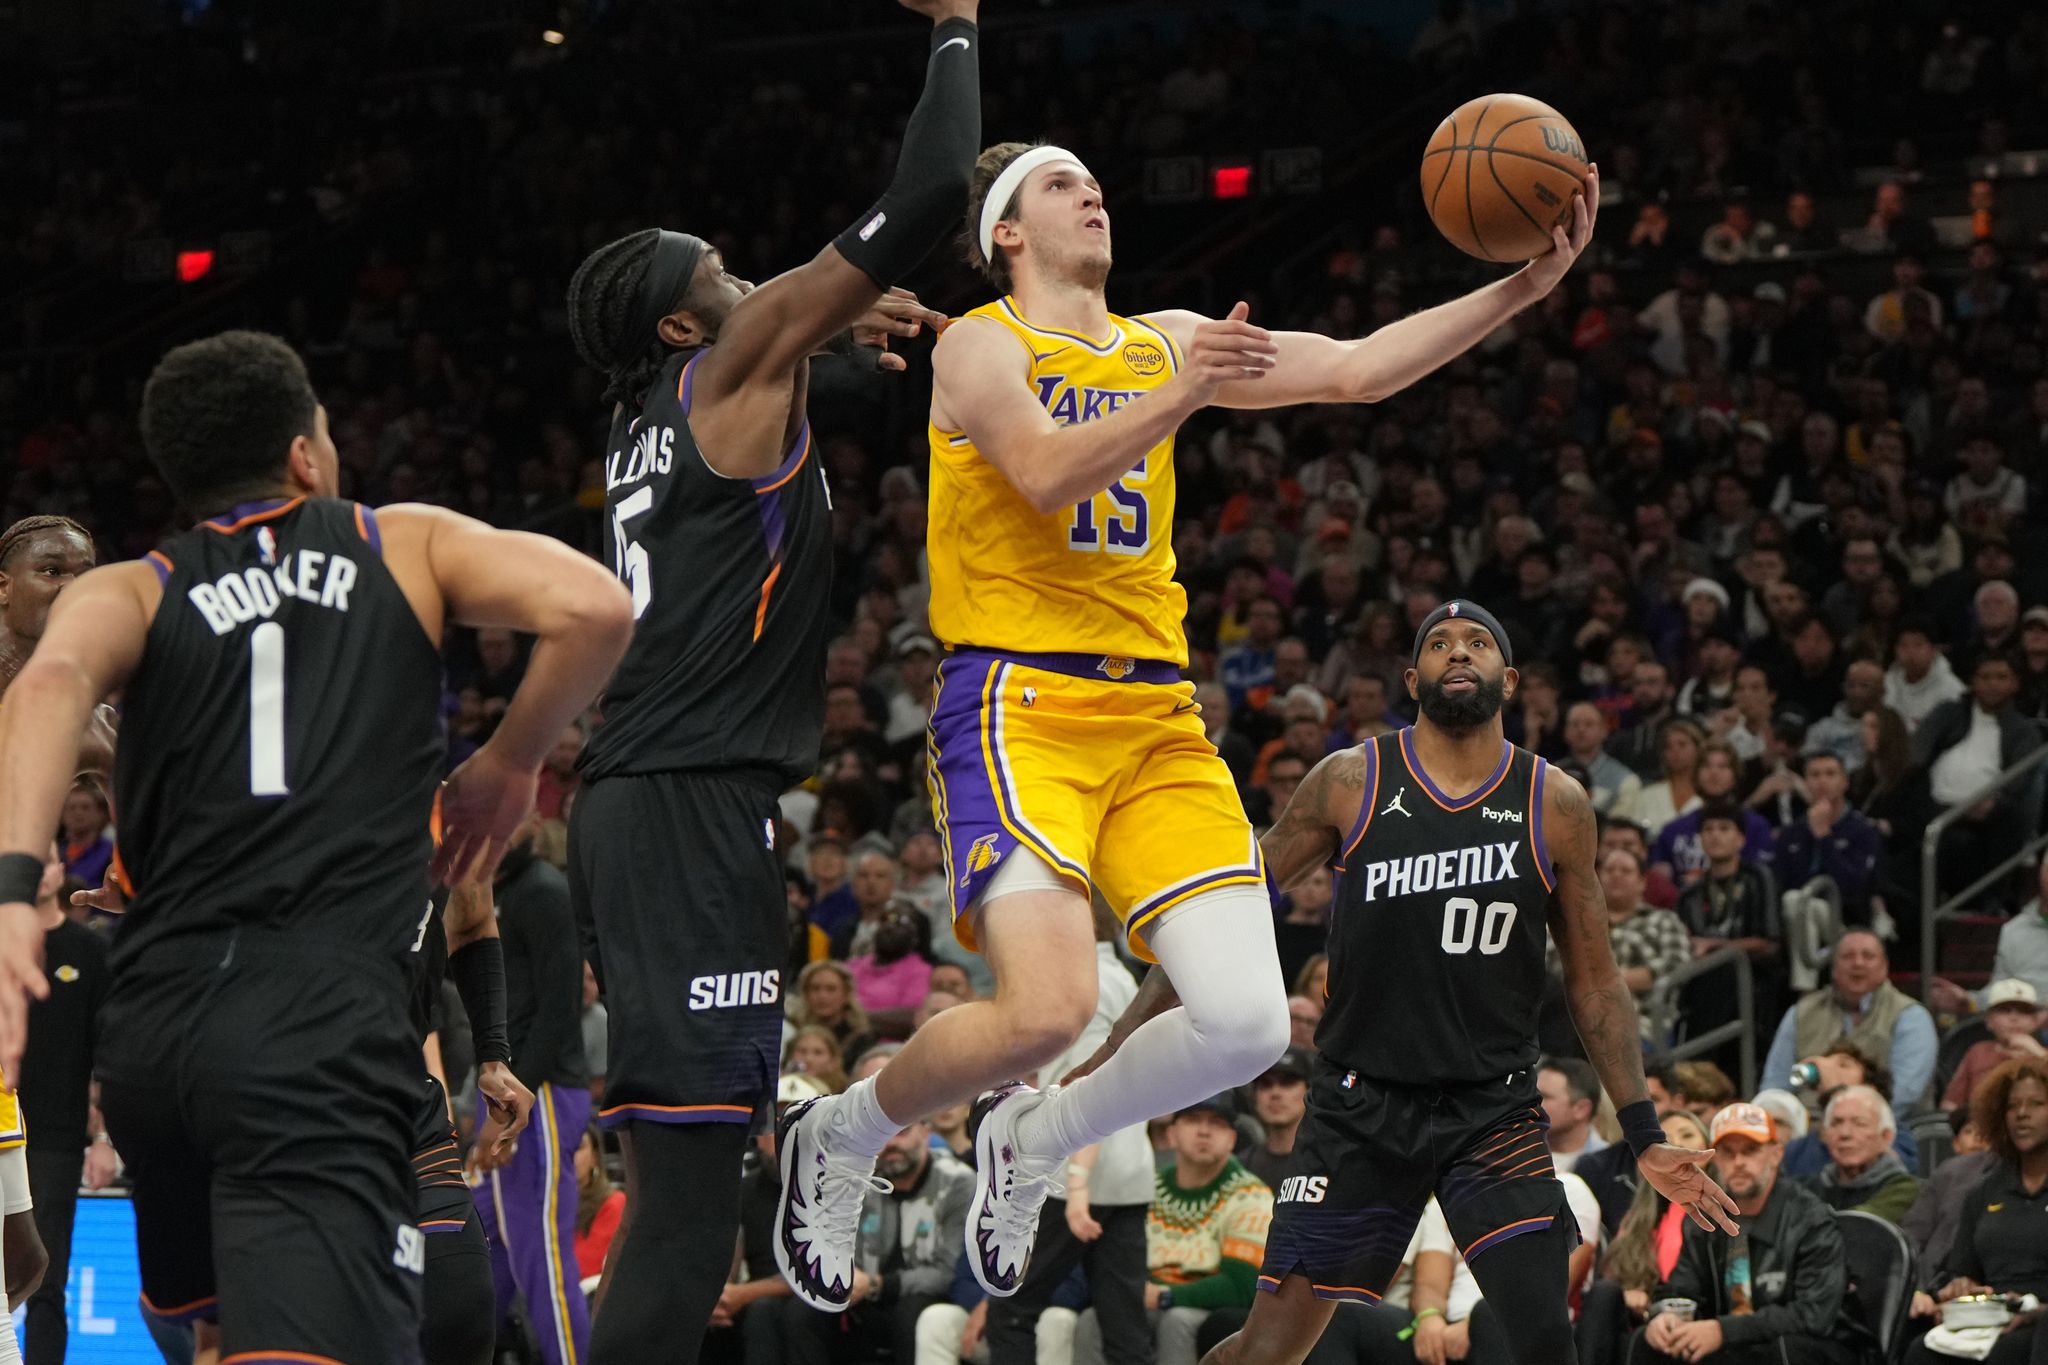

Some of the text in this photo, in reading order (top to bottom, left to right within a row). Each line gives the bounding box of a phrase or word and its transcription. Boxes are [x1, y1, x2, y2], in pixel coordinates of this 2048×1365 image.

[1126, 351, 1161, 366] bibigo
[1069, 456, 1149, 556] 15
[188, 549, 358, 636] BOOKER
[251, 621, 288, 795] 1
[1482, 807, 1522, 823] PayPal
[1365, 841, 1520, 902] PHOENIX
[1441, 897, 1518, 955] 00
[688, 969, 780, 1011] SUNS
[1277, 1176, 1329, 1204] SUNS
